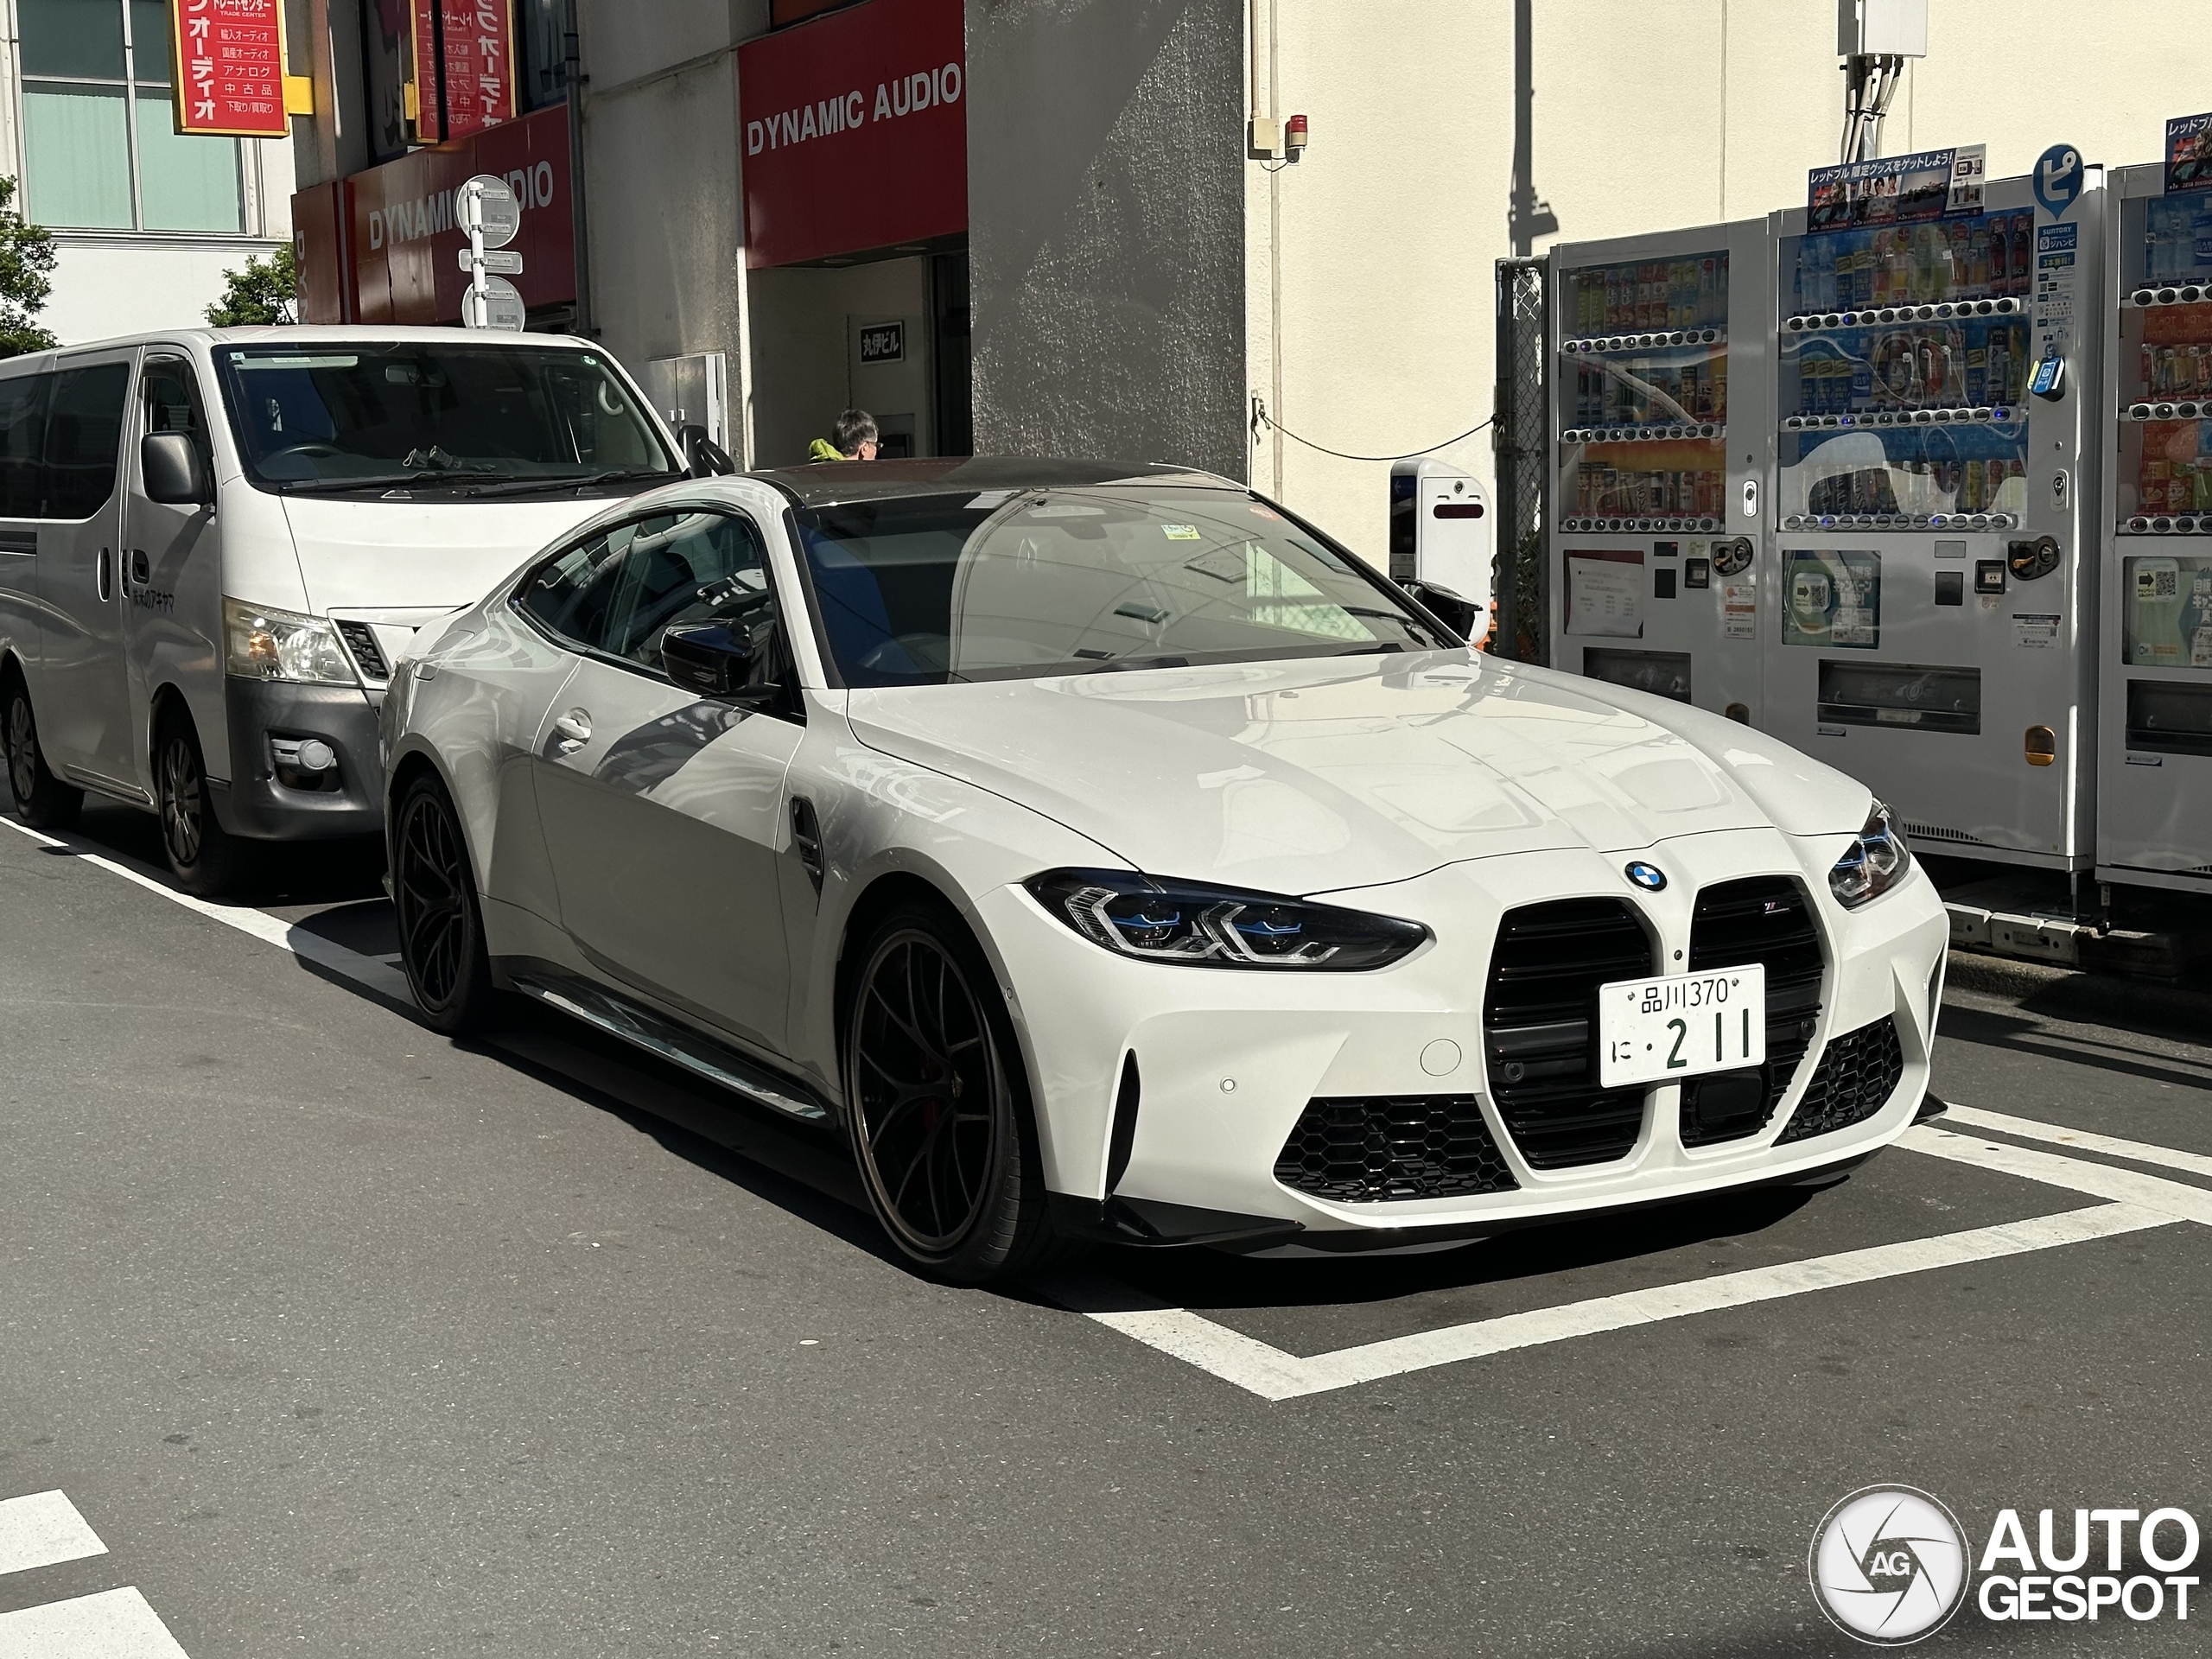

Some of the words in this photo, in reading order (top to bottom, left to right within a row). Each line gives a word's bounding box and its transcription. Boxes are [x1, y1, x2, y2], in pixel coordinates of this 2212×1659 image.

[220, 29, 269, 42] 輸入オーディオ
[222, 47, 270, 60] 国産オーディオ
[223, 65, 271, 78] アナログ
[225, 83, 272, 96] 中古品
[226, 100, 273, 114] 下取り/買取り
[747, 90, 864, 156] DYNAMIC
[873, 62, 962, 122] AUDIO
[1810, 167, 1850, 184] レッドブル
[2044, 150, 2076, 201] ピ
[2043, 226, 2072, 235] SUNTORY
[2050, 238, 2075, 248] ジハンピ
[2158, 315, 2177, 325] HOT
[2183, 315, 2202, 324] HOT
[1637, 483, 1649, 513] BOSS
[1854, 476, 1866, 510] BOSS
[1612, 1041, 1631, 1063] に
